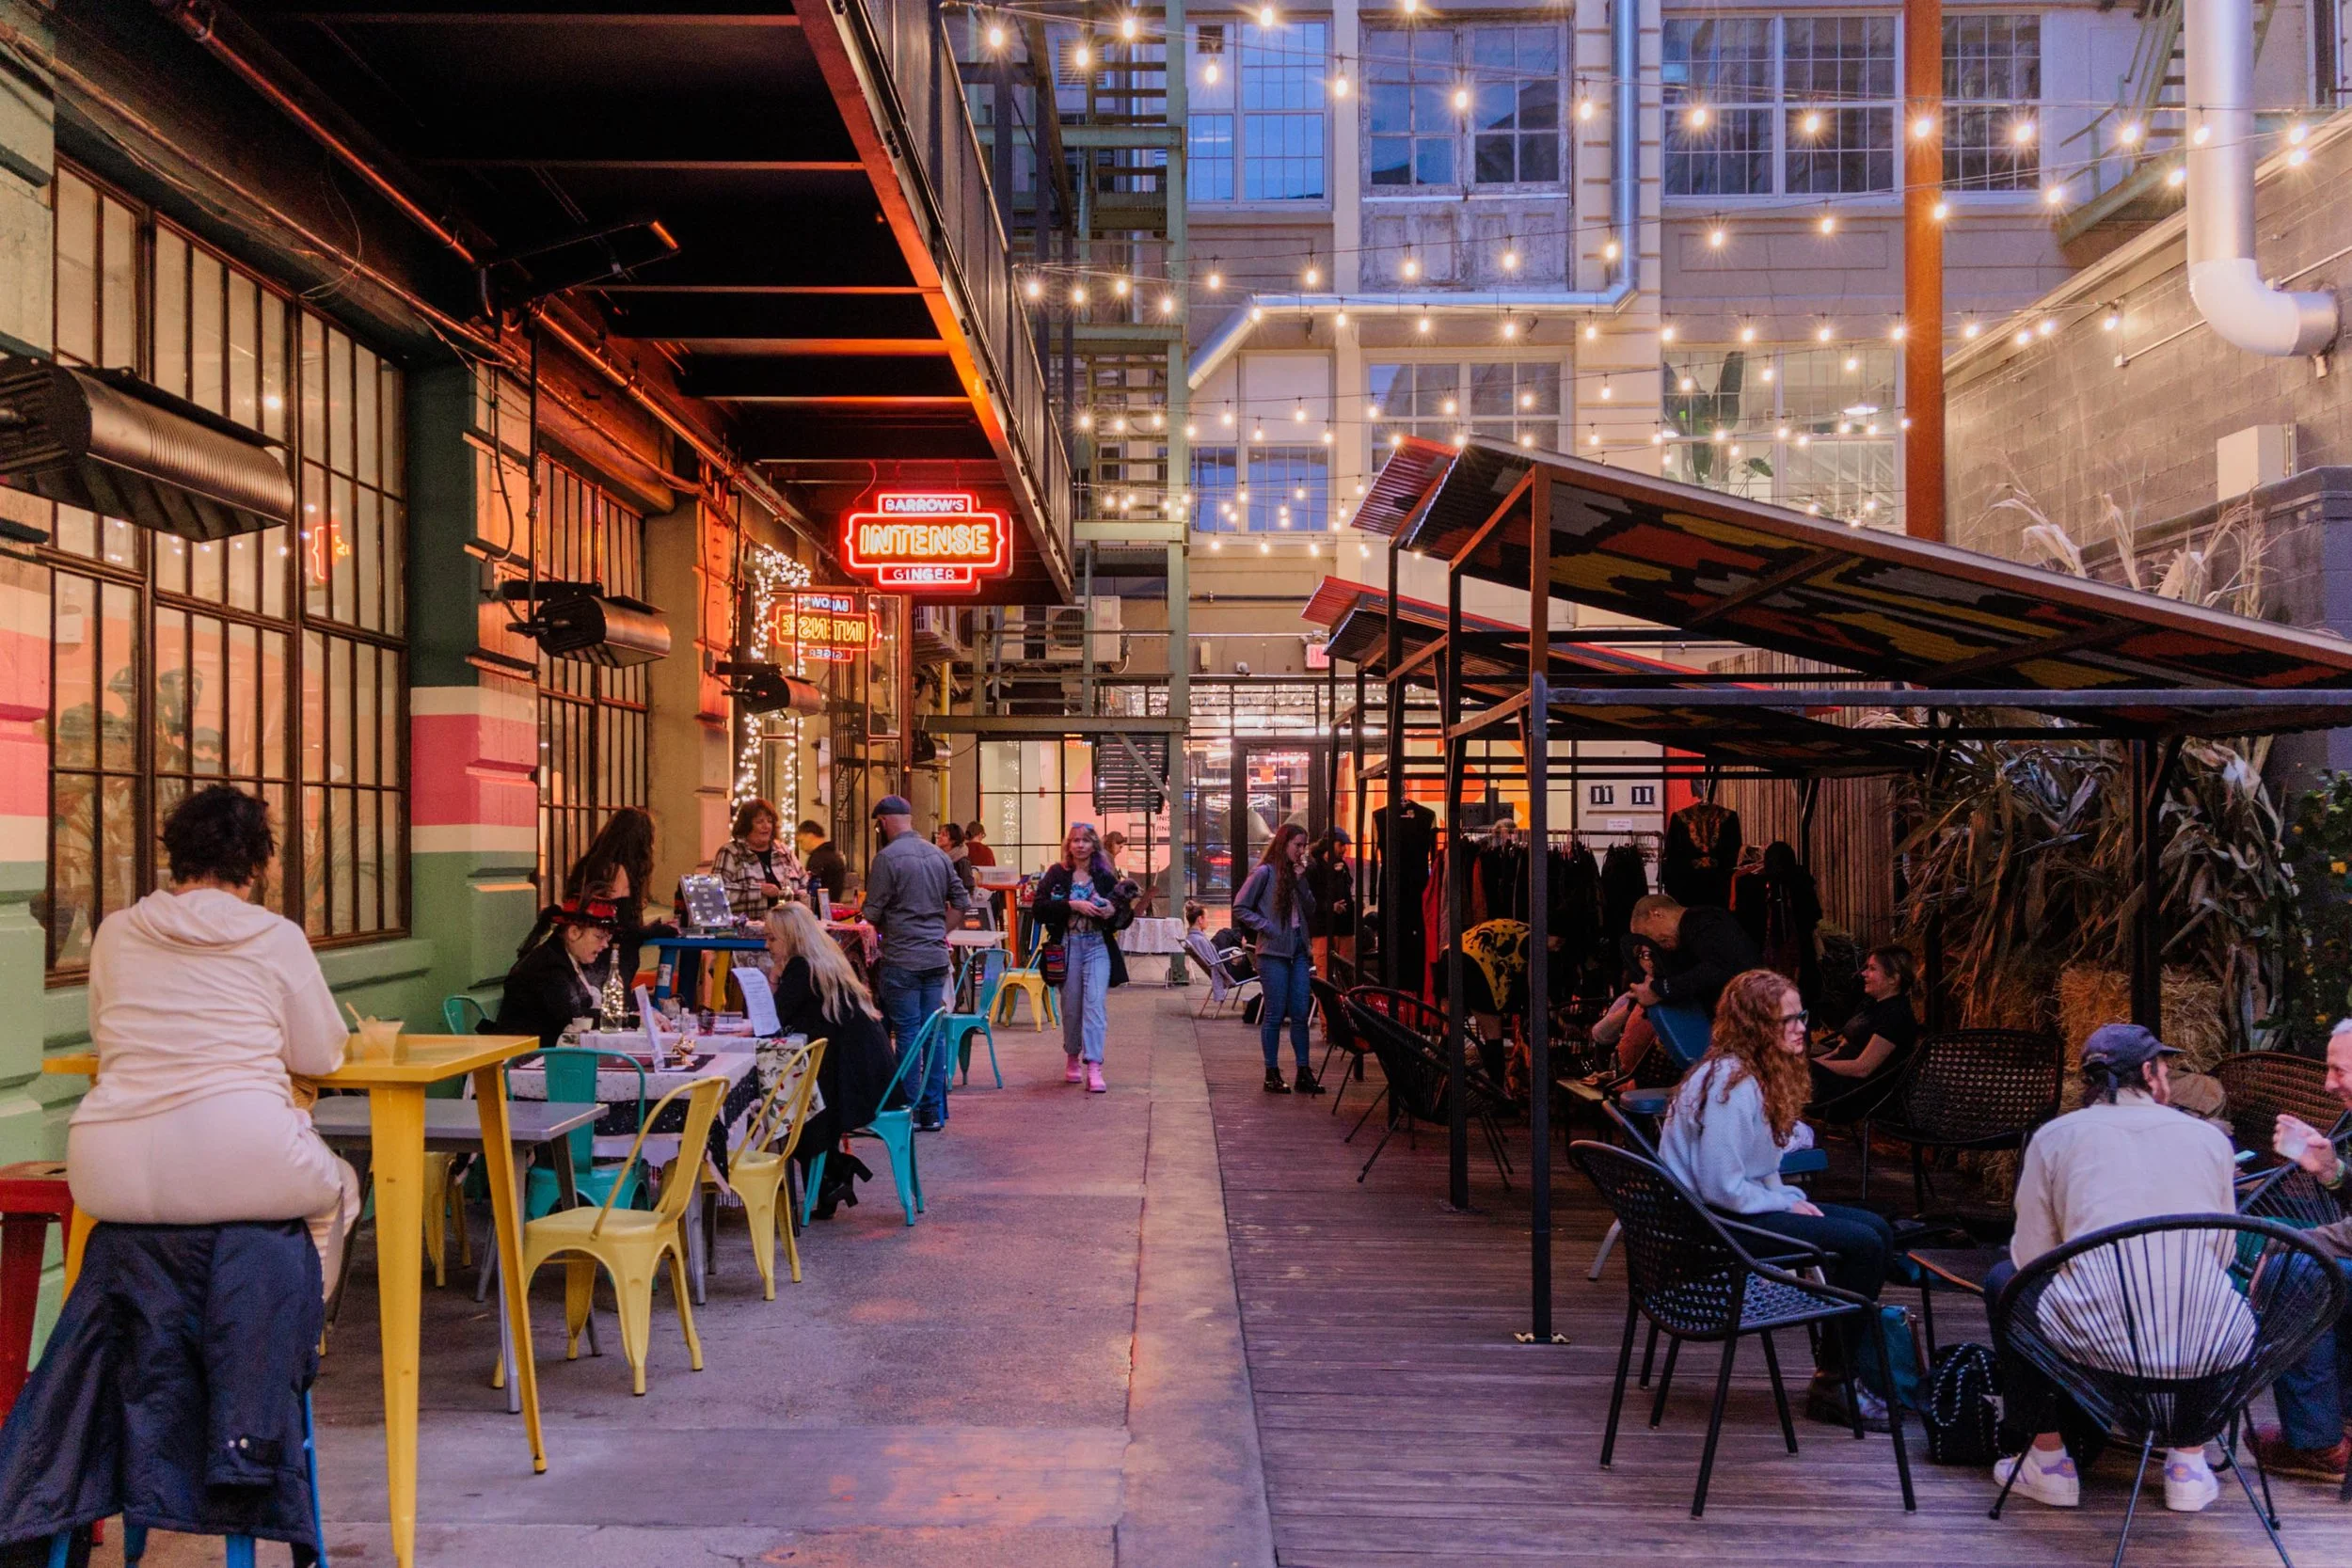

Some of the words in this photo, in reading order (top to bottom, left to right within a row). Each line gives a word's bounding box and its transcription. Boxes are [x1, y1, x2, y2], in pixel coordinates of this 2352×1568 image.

[884, 499, 965, 512] BARROW'S
[859, 523, 991, 556] INTENSE
[893, 568, 955, 581] GINGER
